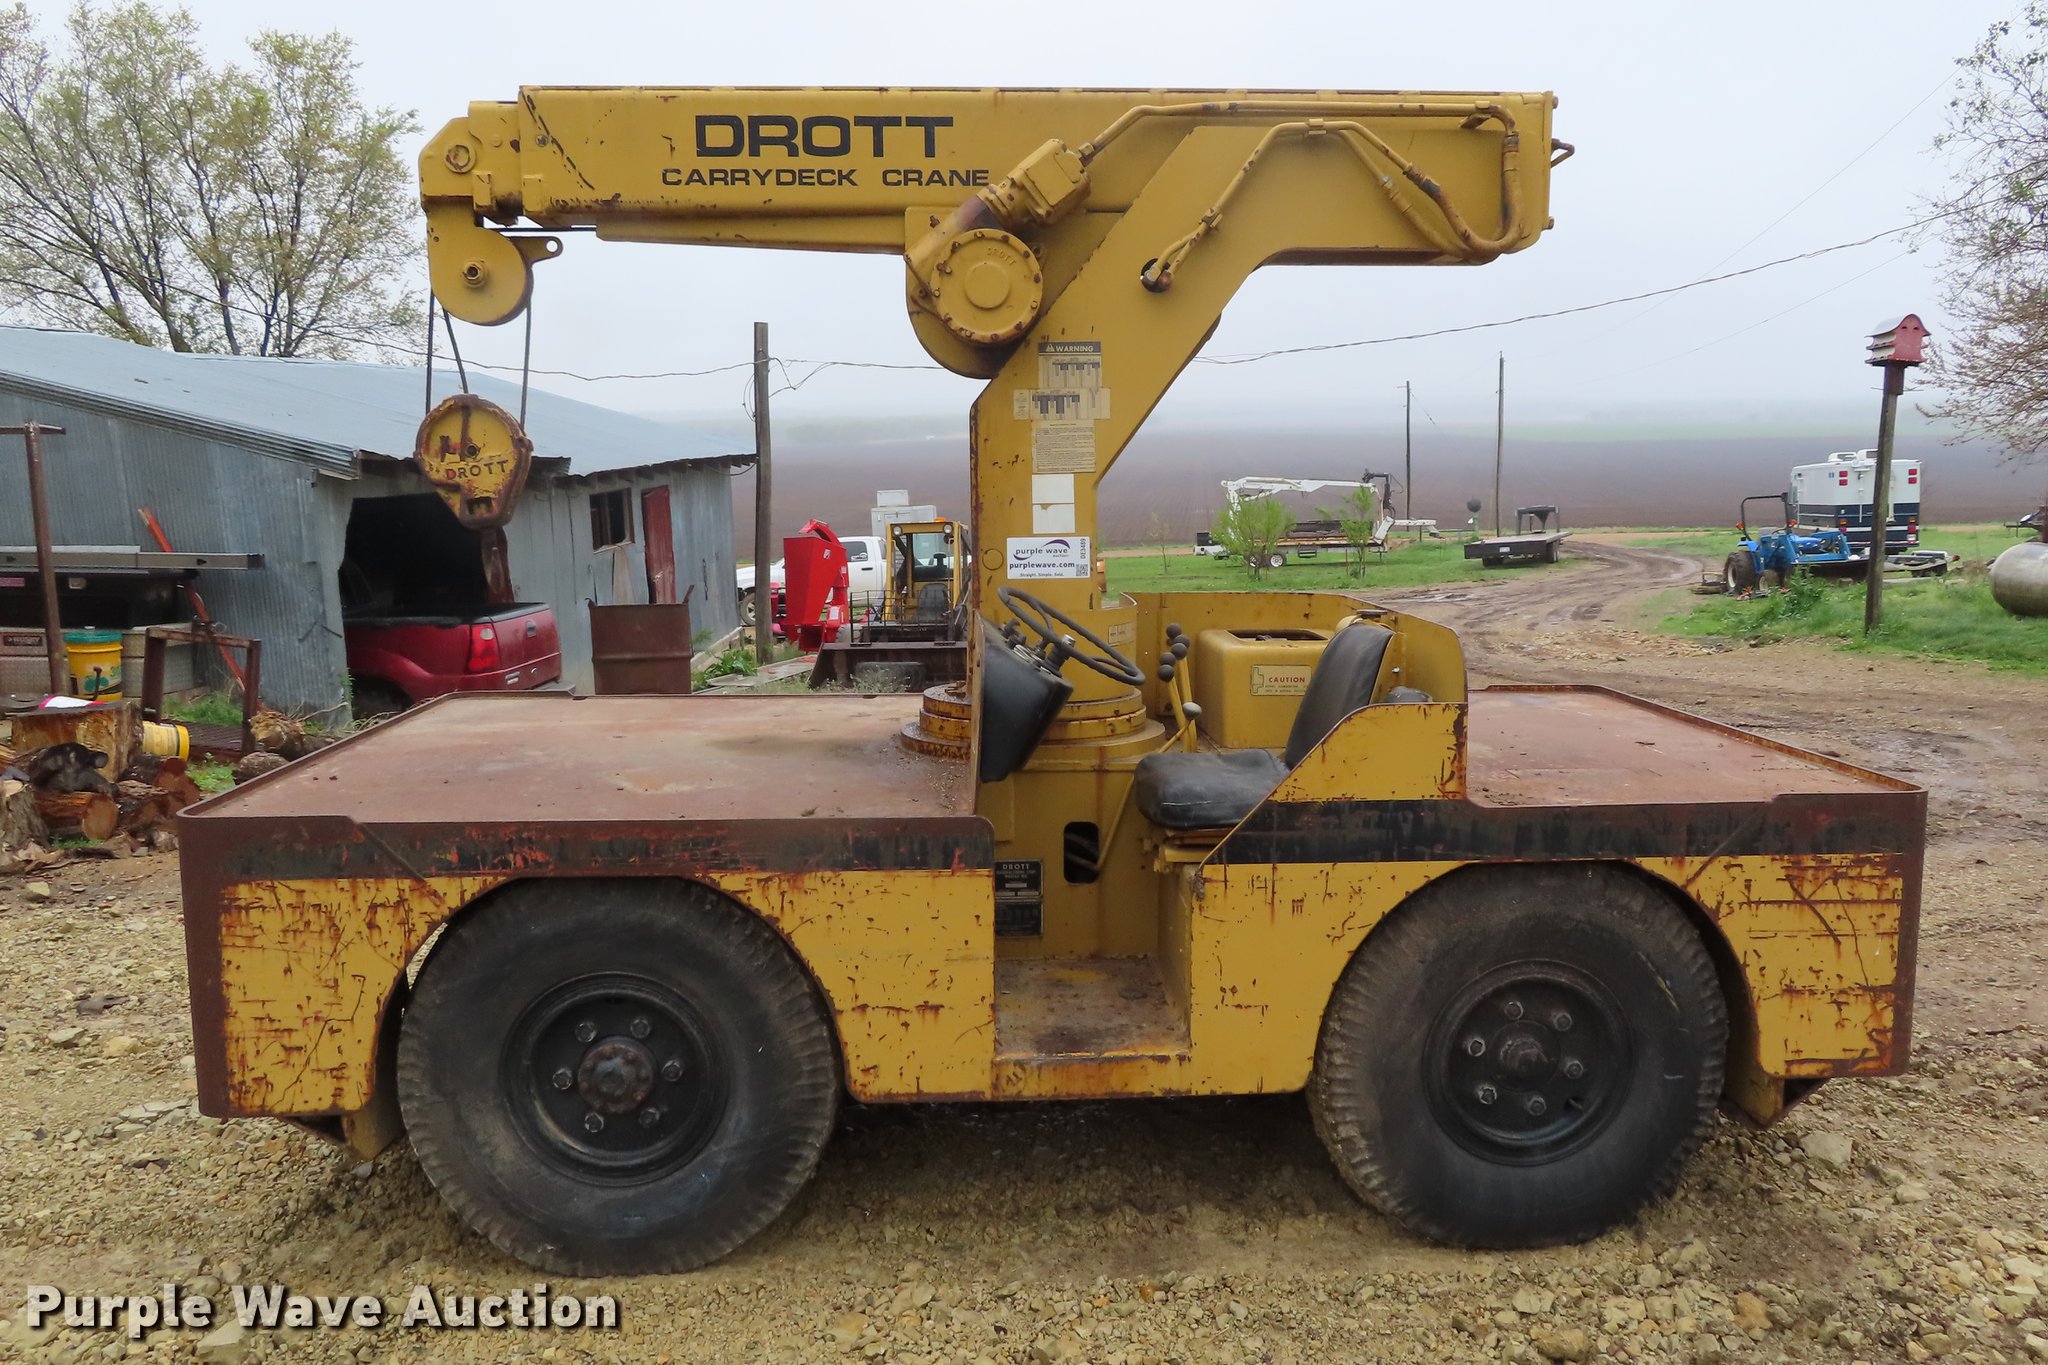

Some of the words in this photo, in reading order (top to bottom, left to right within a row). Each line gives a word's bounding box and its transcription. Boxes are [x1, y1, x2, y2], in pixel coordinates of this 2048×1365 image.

[695, 115, 954, 158] DROTT
[662, 168, 859, 187] CARRYDECK
[882, 168, 990, 187] CRANE
[1055, 345, 1094, 353] WARNING
[445, 460, 508, 479] DROTT
[1015, 547, 1043, 556] purple
[1009, 561, 1075, 569] purplewave.com
